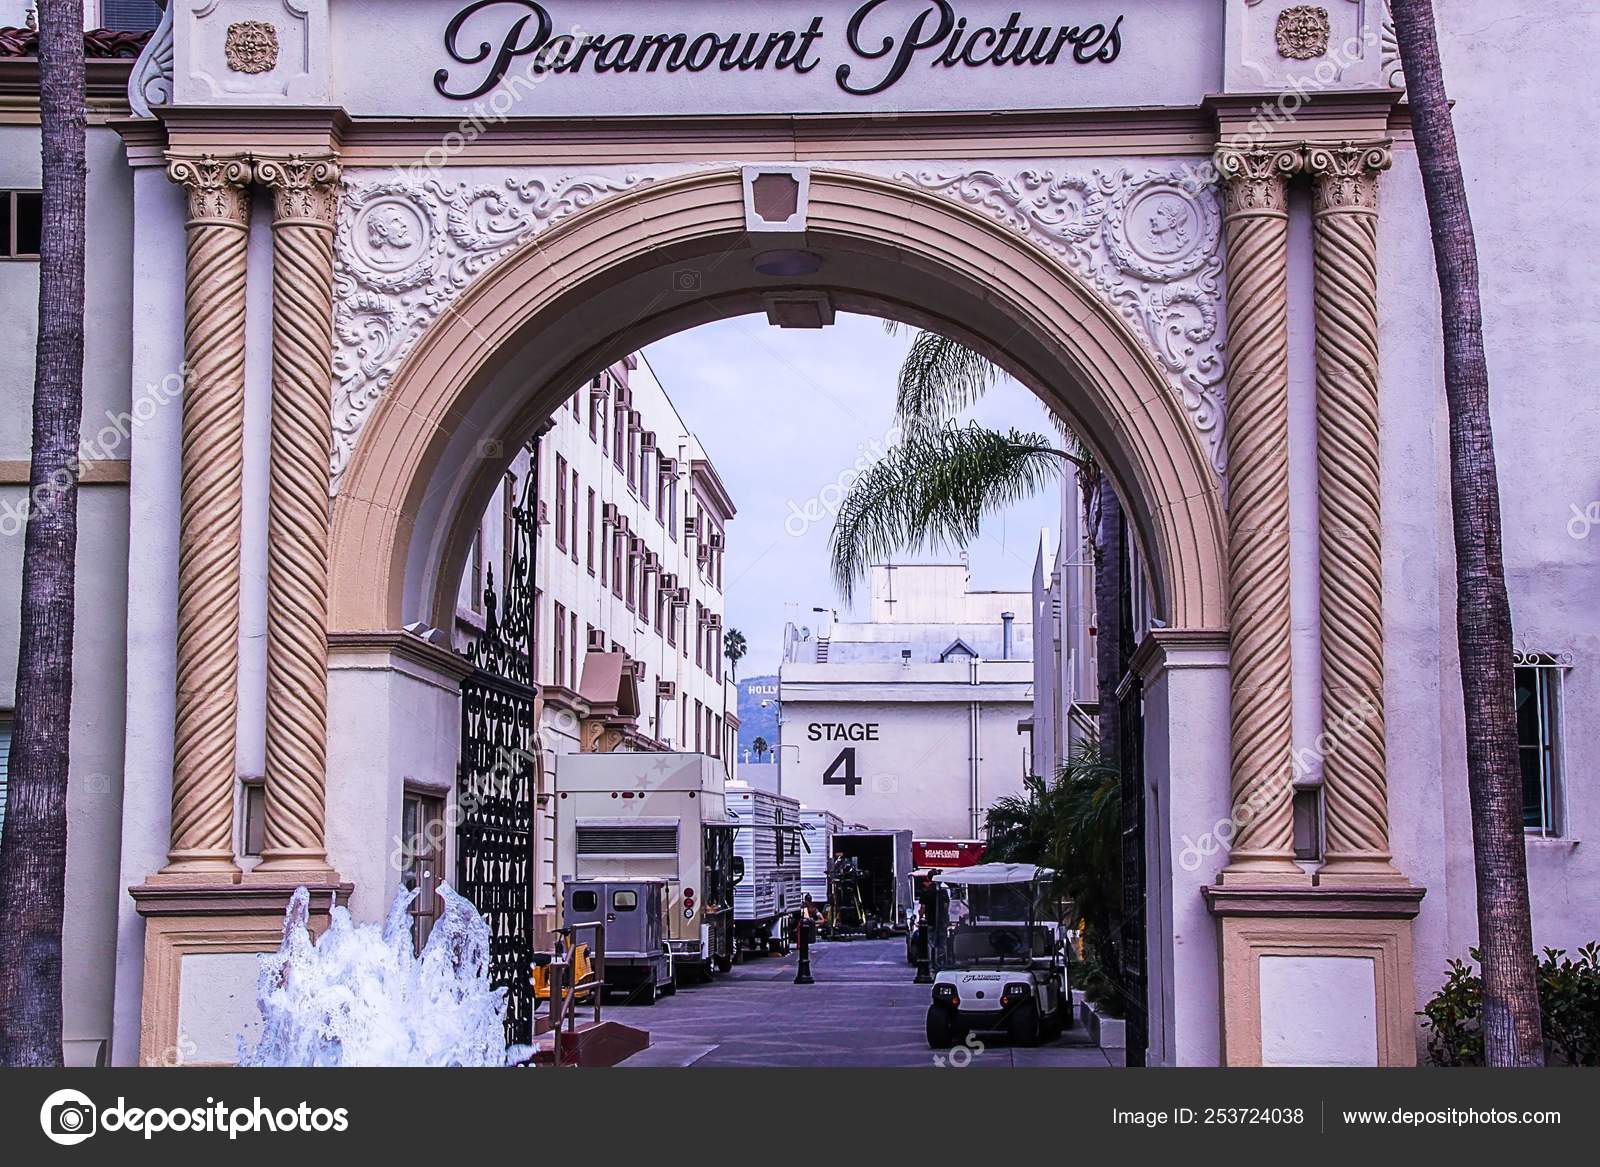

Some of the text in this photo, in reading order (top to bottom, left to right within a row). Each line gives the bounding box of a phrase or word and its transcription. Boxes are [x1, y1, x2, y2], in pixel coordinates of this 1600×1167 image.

[433, 0, 1124, 100] Paramount Pictures
[748, 685, 778, 695] HOLLY
[807, 723, 879, 741] STAGE
[823, 747, 862, 796] 4
